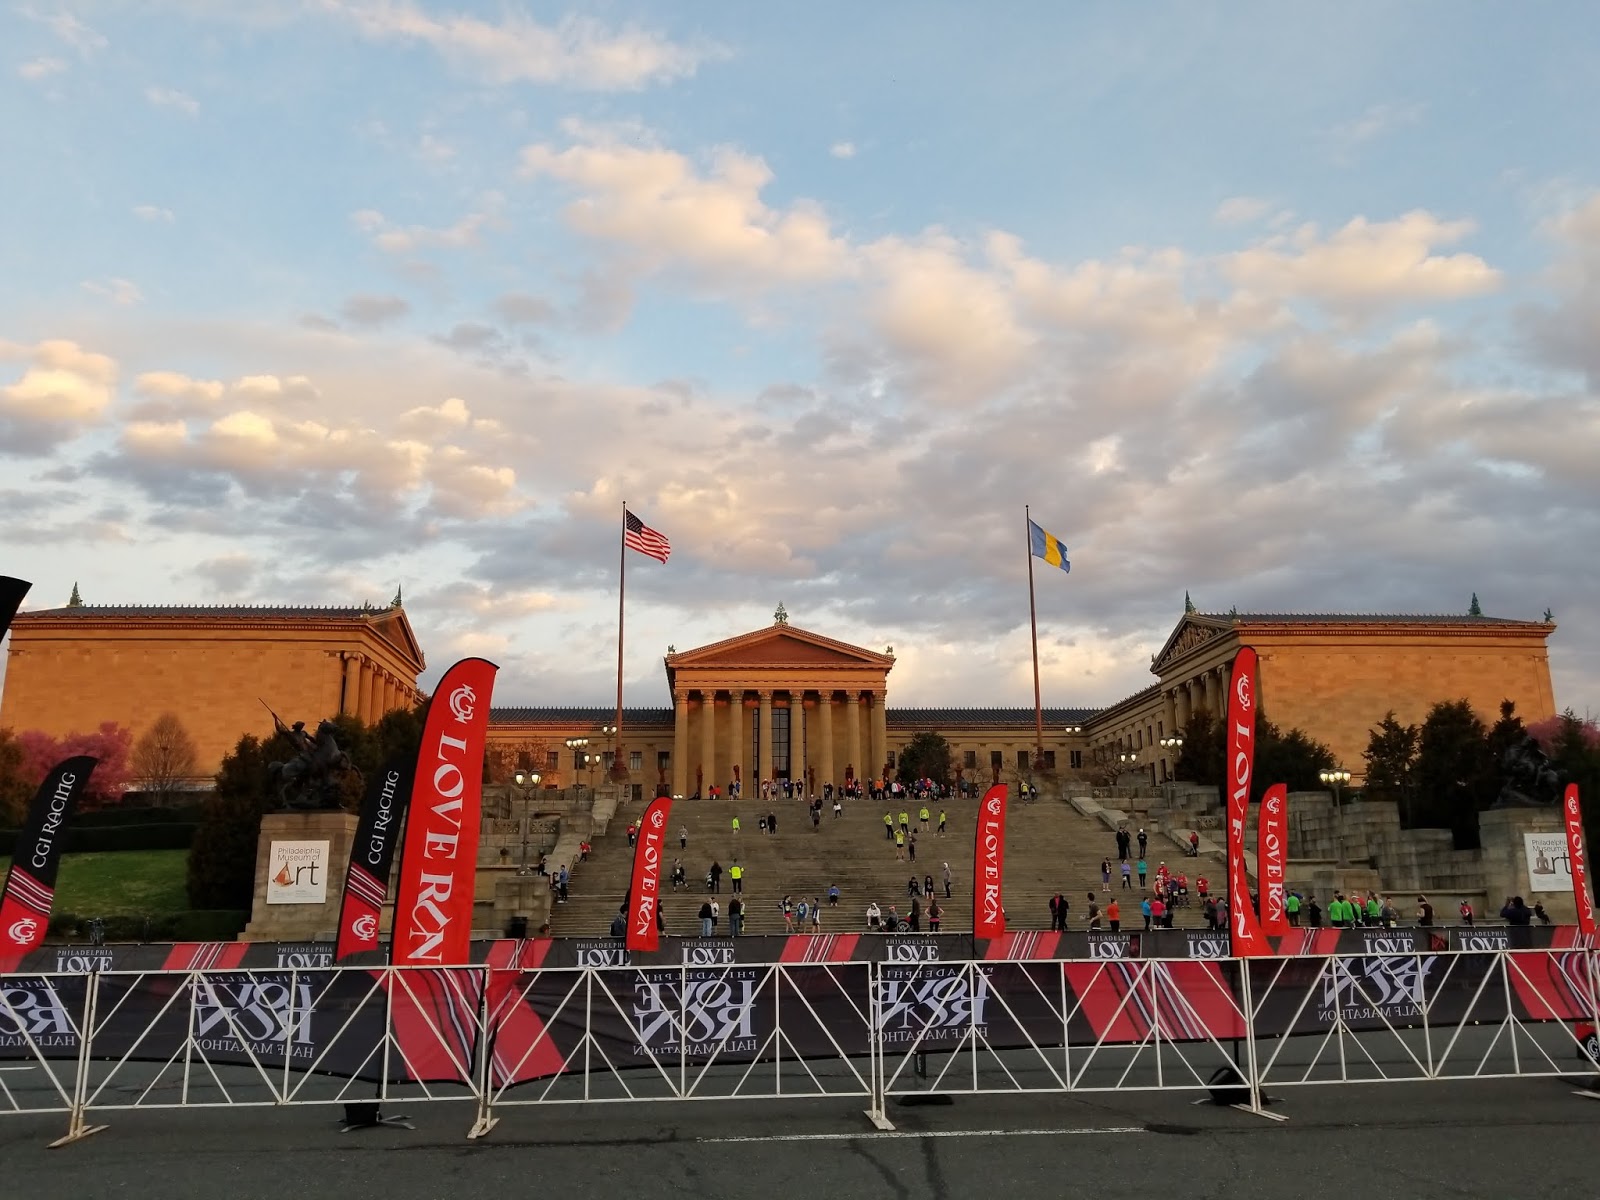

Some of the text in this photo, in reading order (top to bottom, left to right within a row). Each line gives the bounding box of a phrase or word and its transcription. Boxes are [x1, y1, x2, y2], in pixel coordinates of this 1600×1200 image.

[32, 771, 77, 869] CGI RACING
[368, 769, 400, 866] CGI RACING
[278, 847, 321, 856] Philadelphia
[407, 730, 468, 964] LOVE RUN
[642, 832, 659, 892] LOVE
[985, 821, 999, 880] LOVE
[1265, 818, 1283, 878] LOVE
[636, 895, 655, 938] RUN
[983, 882, 999, 926] RUN
[1267, 880, 1284, 923] RUN
[57, 956, 113, 973] LOVE
[276, 953, 333, 969] LOVE
[682, 947, 736, 965] LOVE
[886, 945, 940, 961] LOVE
[1363, 938, 1416, 954] LOVE
[1458, 937, 1509, 952] LOVE
